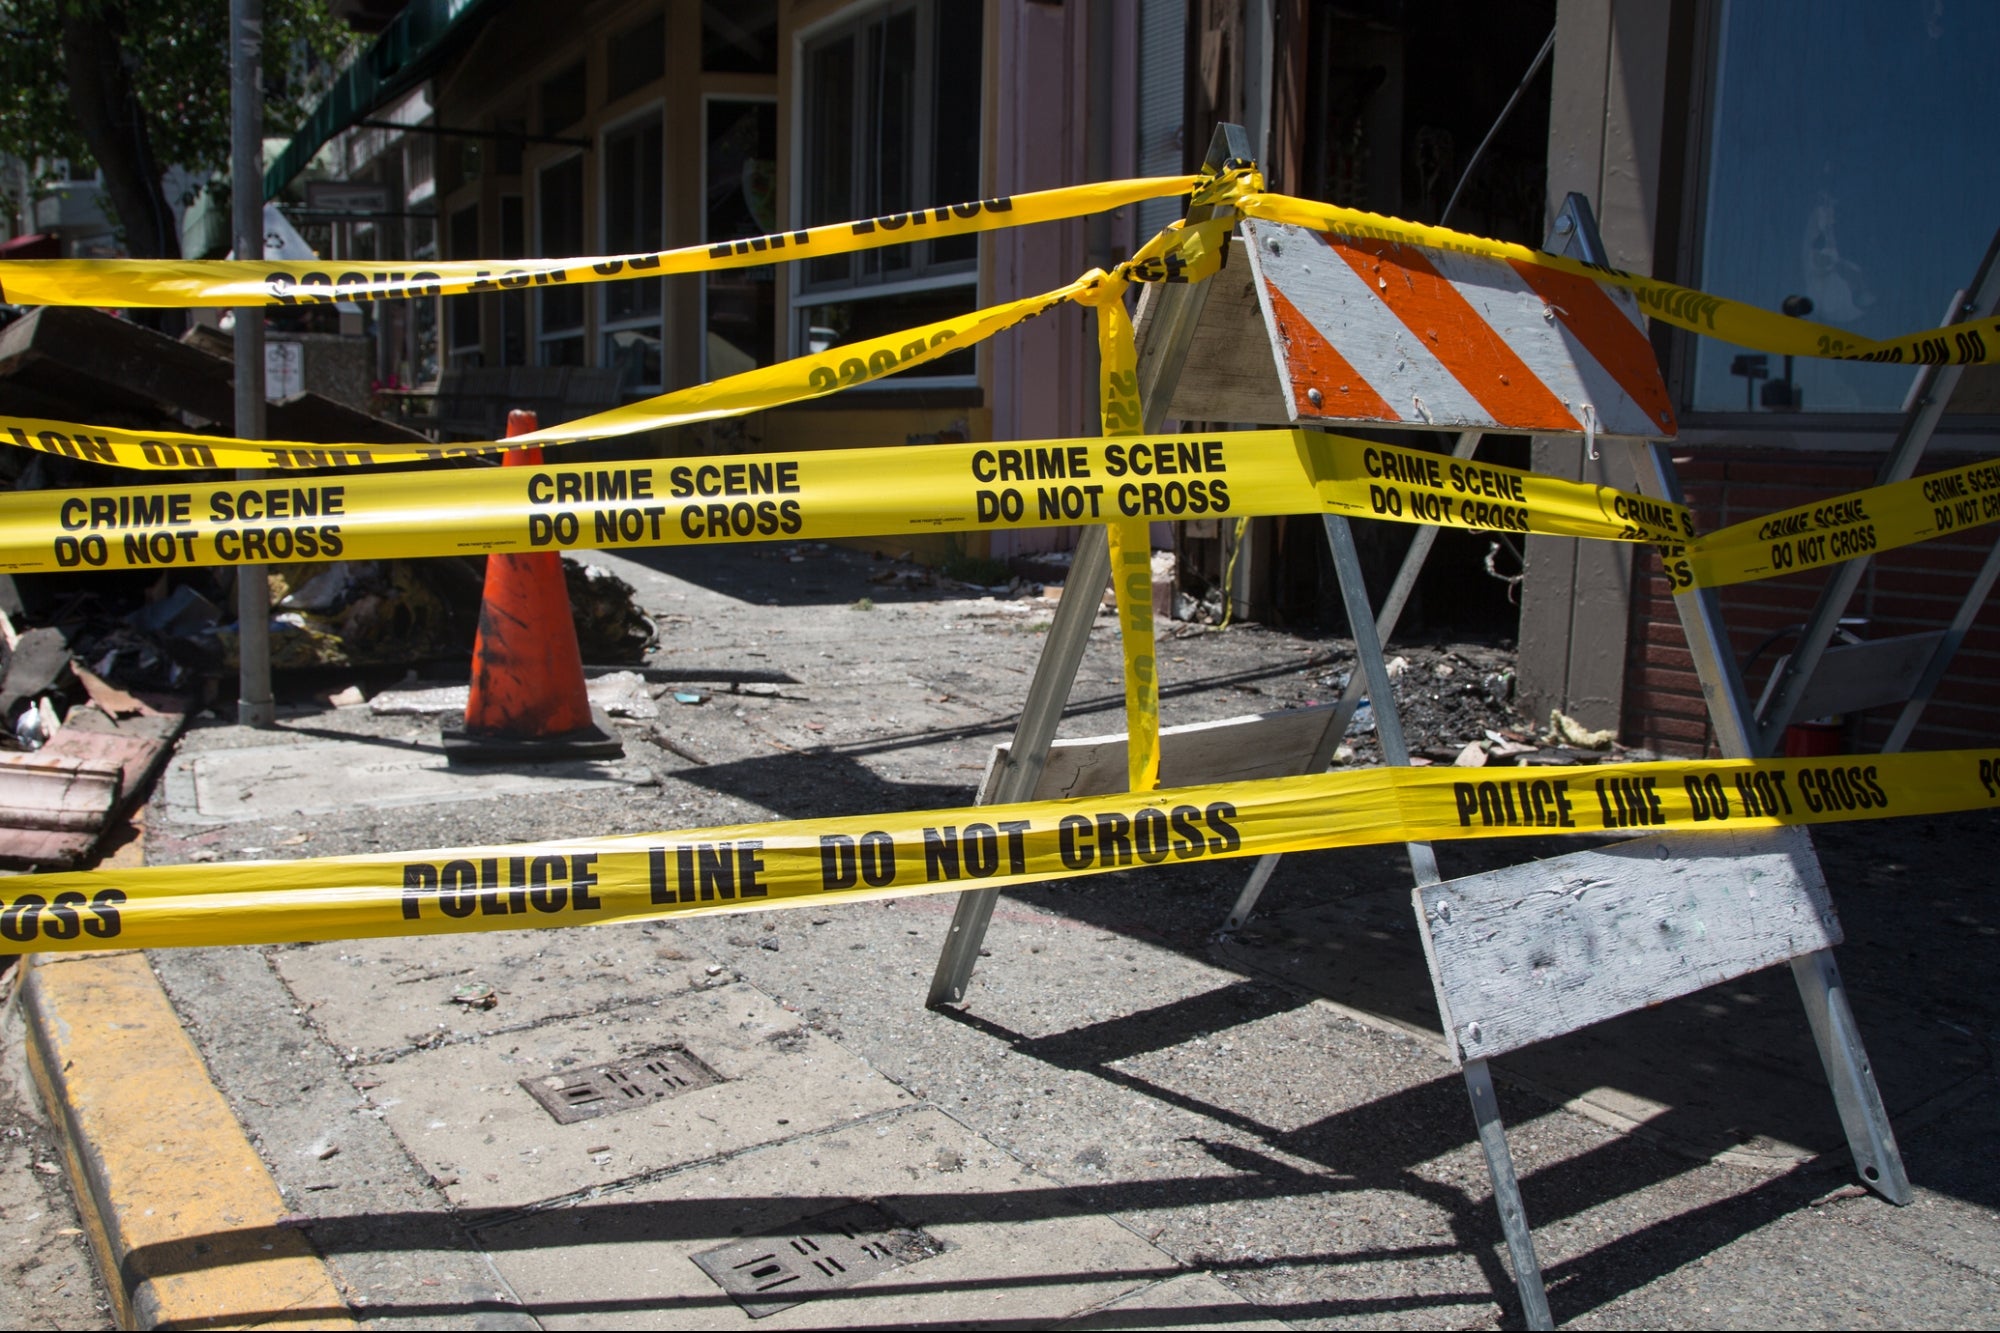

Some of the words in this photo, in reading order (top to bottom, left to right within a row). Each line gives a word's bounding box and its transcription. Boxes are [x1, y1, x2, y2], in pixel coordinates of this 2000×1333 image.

[528, 468, 654, 504] CRIME
[670, 461, 801, 498] SCENE
[972, 446, 1091, 482] CRIME
[1105, 441, 1227, 477] SCENE
[1363, 447, 1444, 489] CRIME
[1449, 463, 1528, 503] SCENE
[60, 493, 192, 531] CRIME
[209, 486, 345, 524] SCENE
[976, 488, 1024, 523] DO
[1038, 485, 1104, 521] NOT
[1118, 479, 1231, 518] CROSS
[1369, 484, 1403, 517] DO
[1410, 491, 1453, 523] NOT
[1460, 499, 1531, 533] CROSS
[1923, 474, 1969, 503] CRIME
[529, 511, 579, 546] DO
[595, 506, 665, 543] NOT
[680, 500, 802, 539] CROSS
[1614, 495, 1678, 532] CRIME
[1758, 512, 1817, 541] CRIME
[1814, 499, 1871, 529] SCENE
[1934, 506, 1953, 531] DO
[1955, 499, 1979, 525] NOT
[54, 534, 109, 567] DO
[123, 531, 199, 564] NOT
[214, 525, 344, 561] CROSS
[1771, 542, 1793, 570] DO
[1798, 532, 1826, 565] NOT
[1830, 524, 1877, 558] CROSS
[1454, 780, 1576, 828] POLICE
[1596, 776, 1666, 828] LINE
[1685, 774, 1730, 821] DO
[1735, 770, 1793, 818] NOT
[1797, 765, 1889, 812] CROSS
[402, 853, 601, 920] POLICE
[649, 840, 768, 905] LINE
[819, 831, 897, 891] DO
[924, 820, 1032, 881] NOT
[1059, 801, 1242, 869] CROSS
